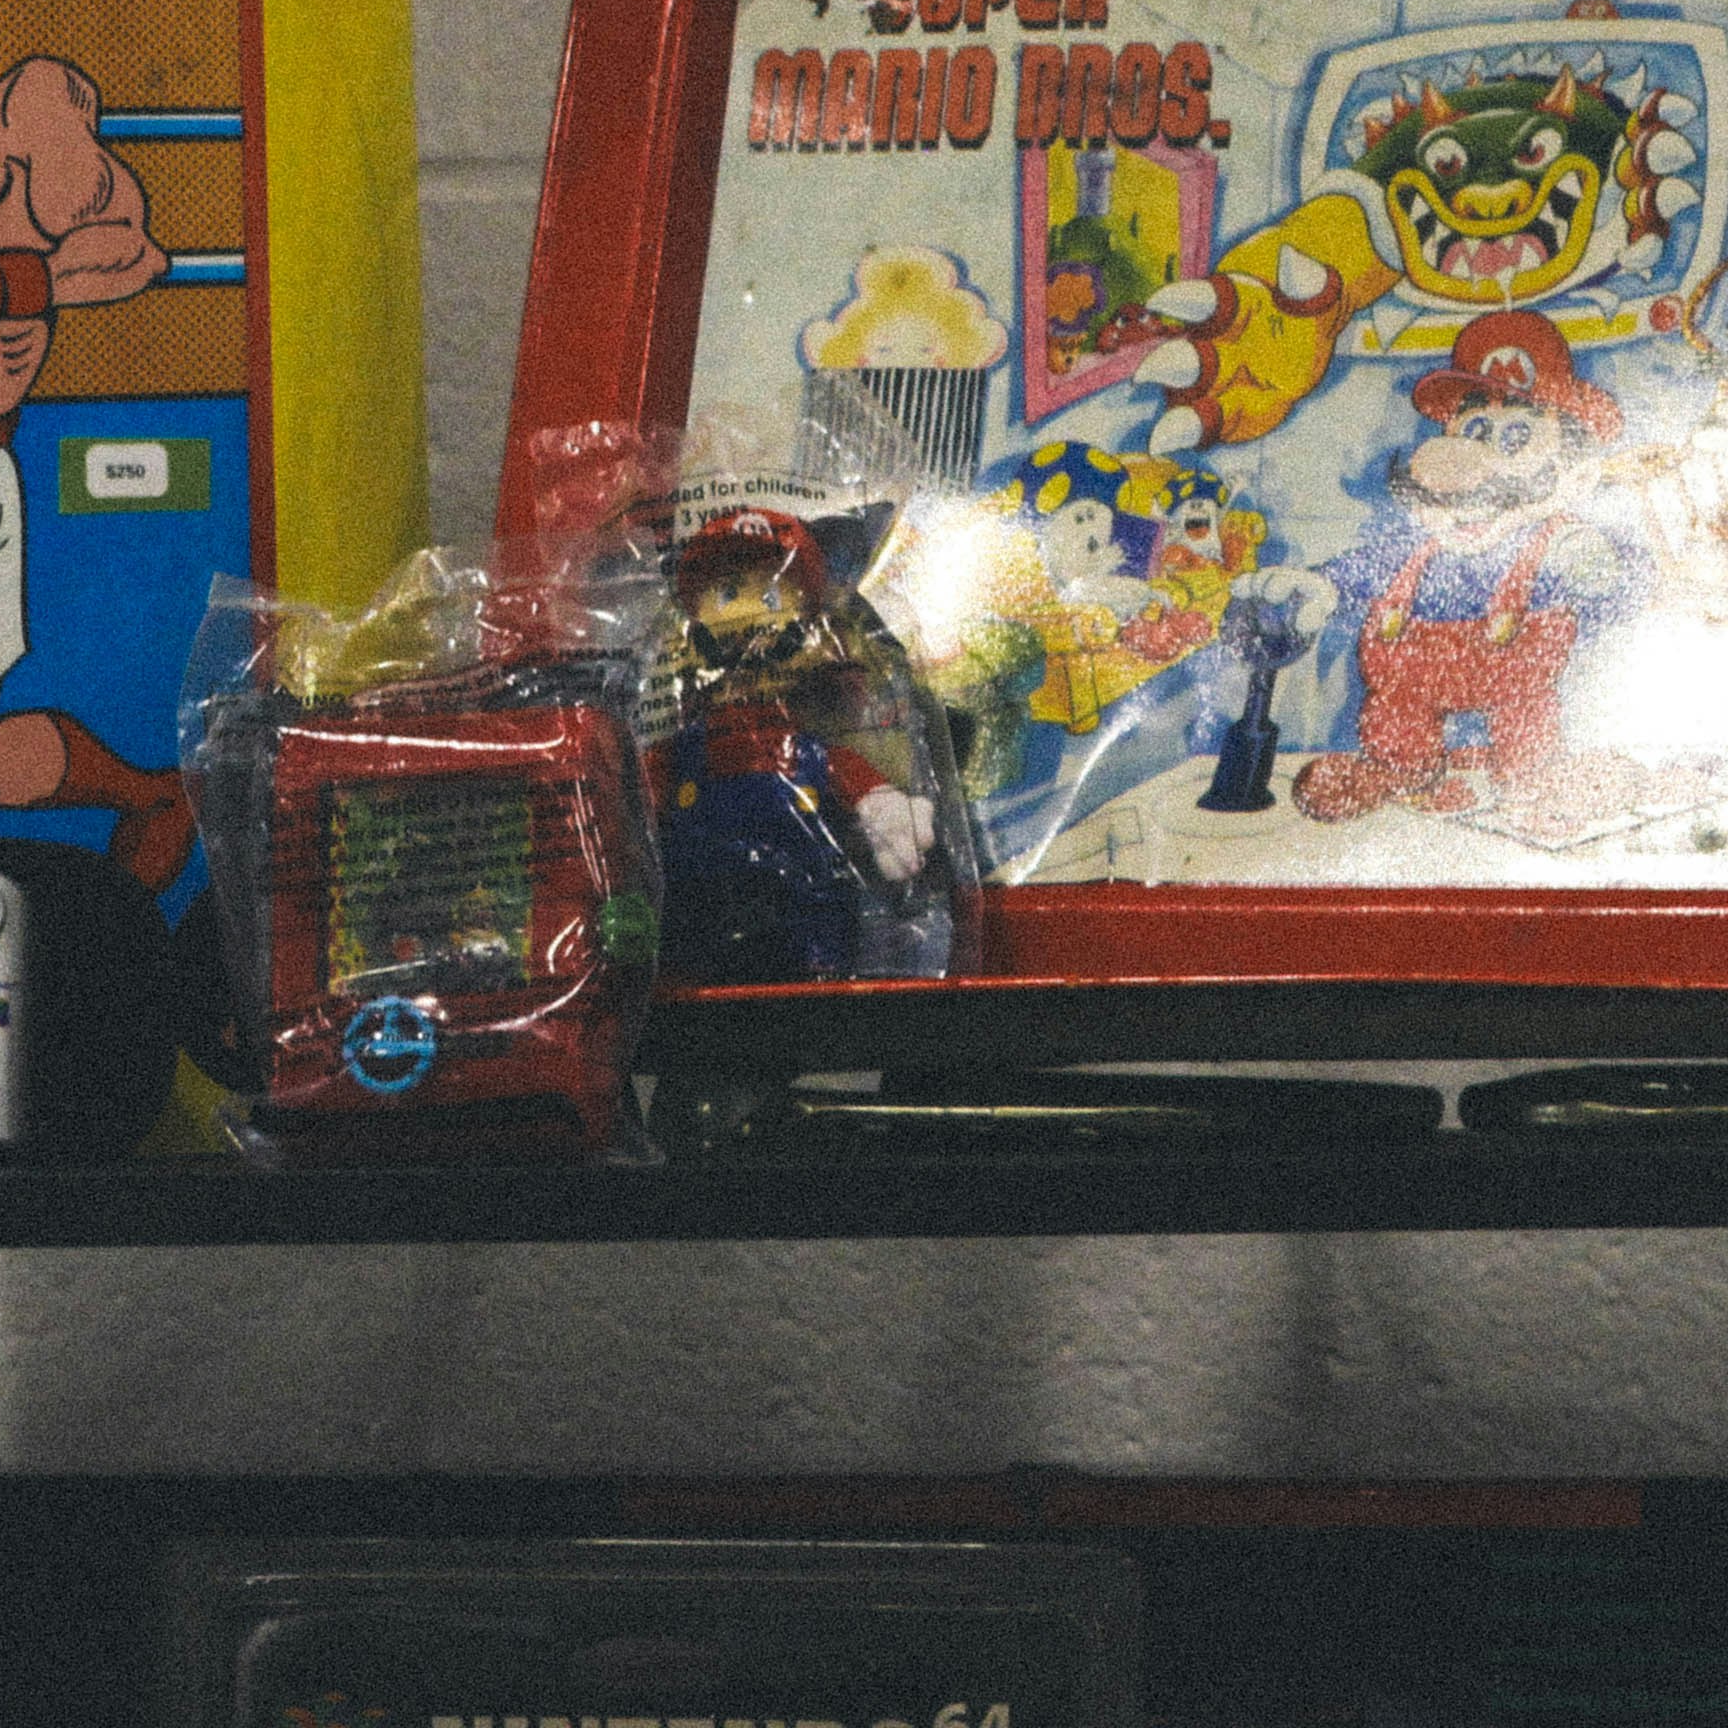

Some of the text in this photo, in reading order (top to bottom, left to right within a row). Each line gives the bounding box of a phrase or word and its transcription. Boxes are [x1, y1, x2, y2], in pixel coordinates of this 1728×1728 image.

[747, 41, 1232, 152] MARIO BROS.
[709, 479, 738, 498] for
[745, 478, 826, 501] children
